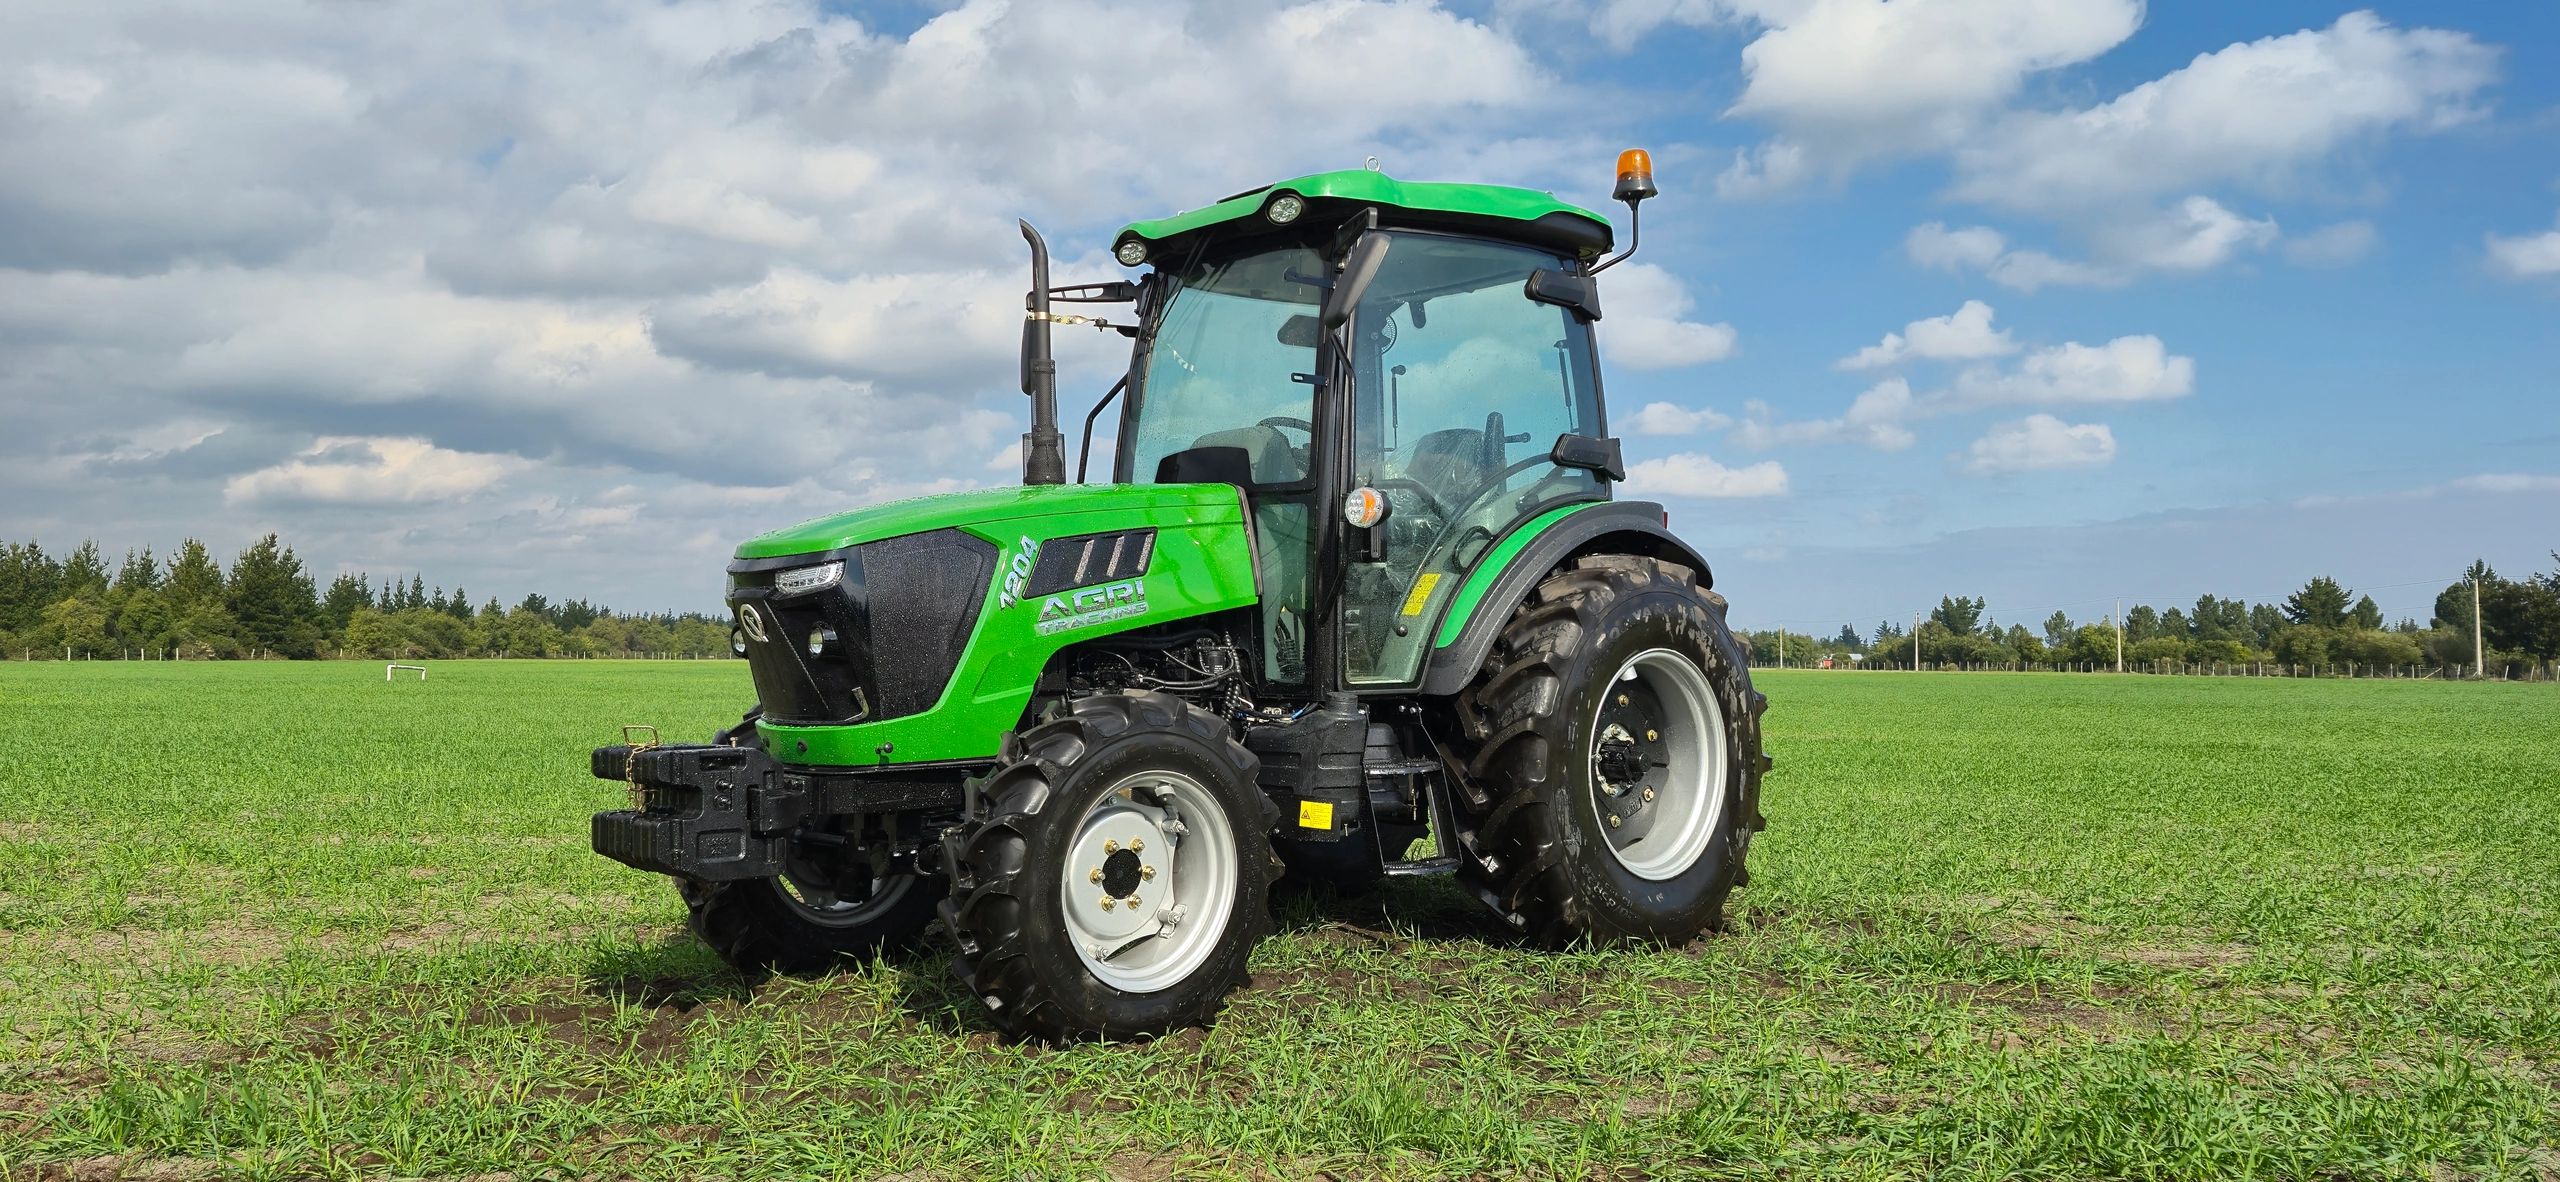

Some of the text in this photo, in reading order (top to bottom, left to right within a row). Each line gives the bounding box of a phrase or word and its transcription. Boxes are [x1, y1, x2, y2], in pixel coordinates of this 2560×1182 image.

[1000, 535, 1038, 609] 1204
[1037, 602, 1148, 633] TRACKING
[1038, 580, 1145, 621] AGRI
